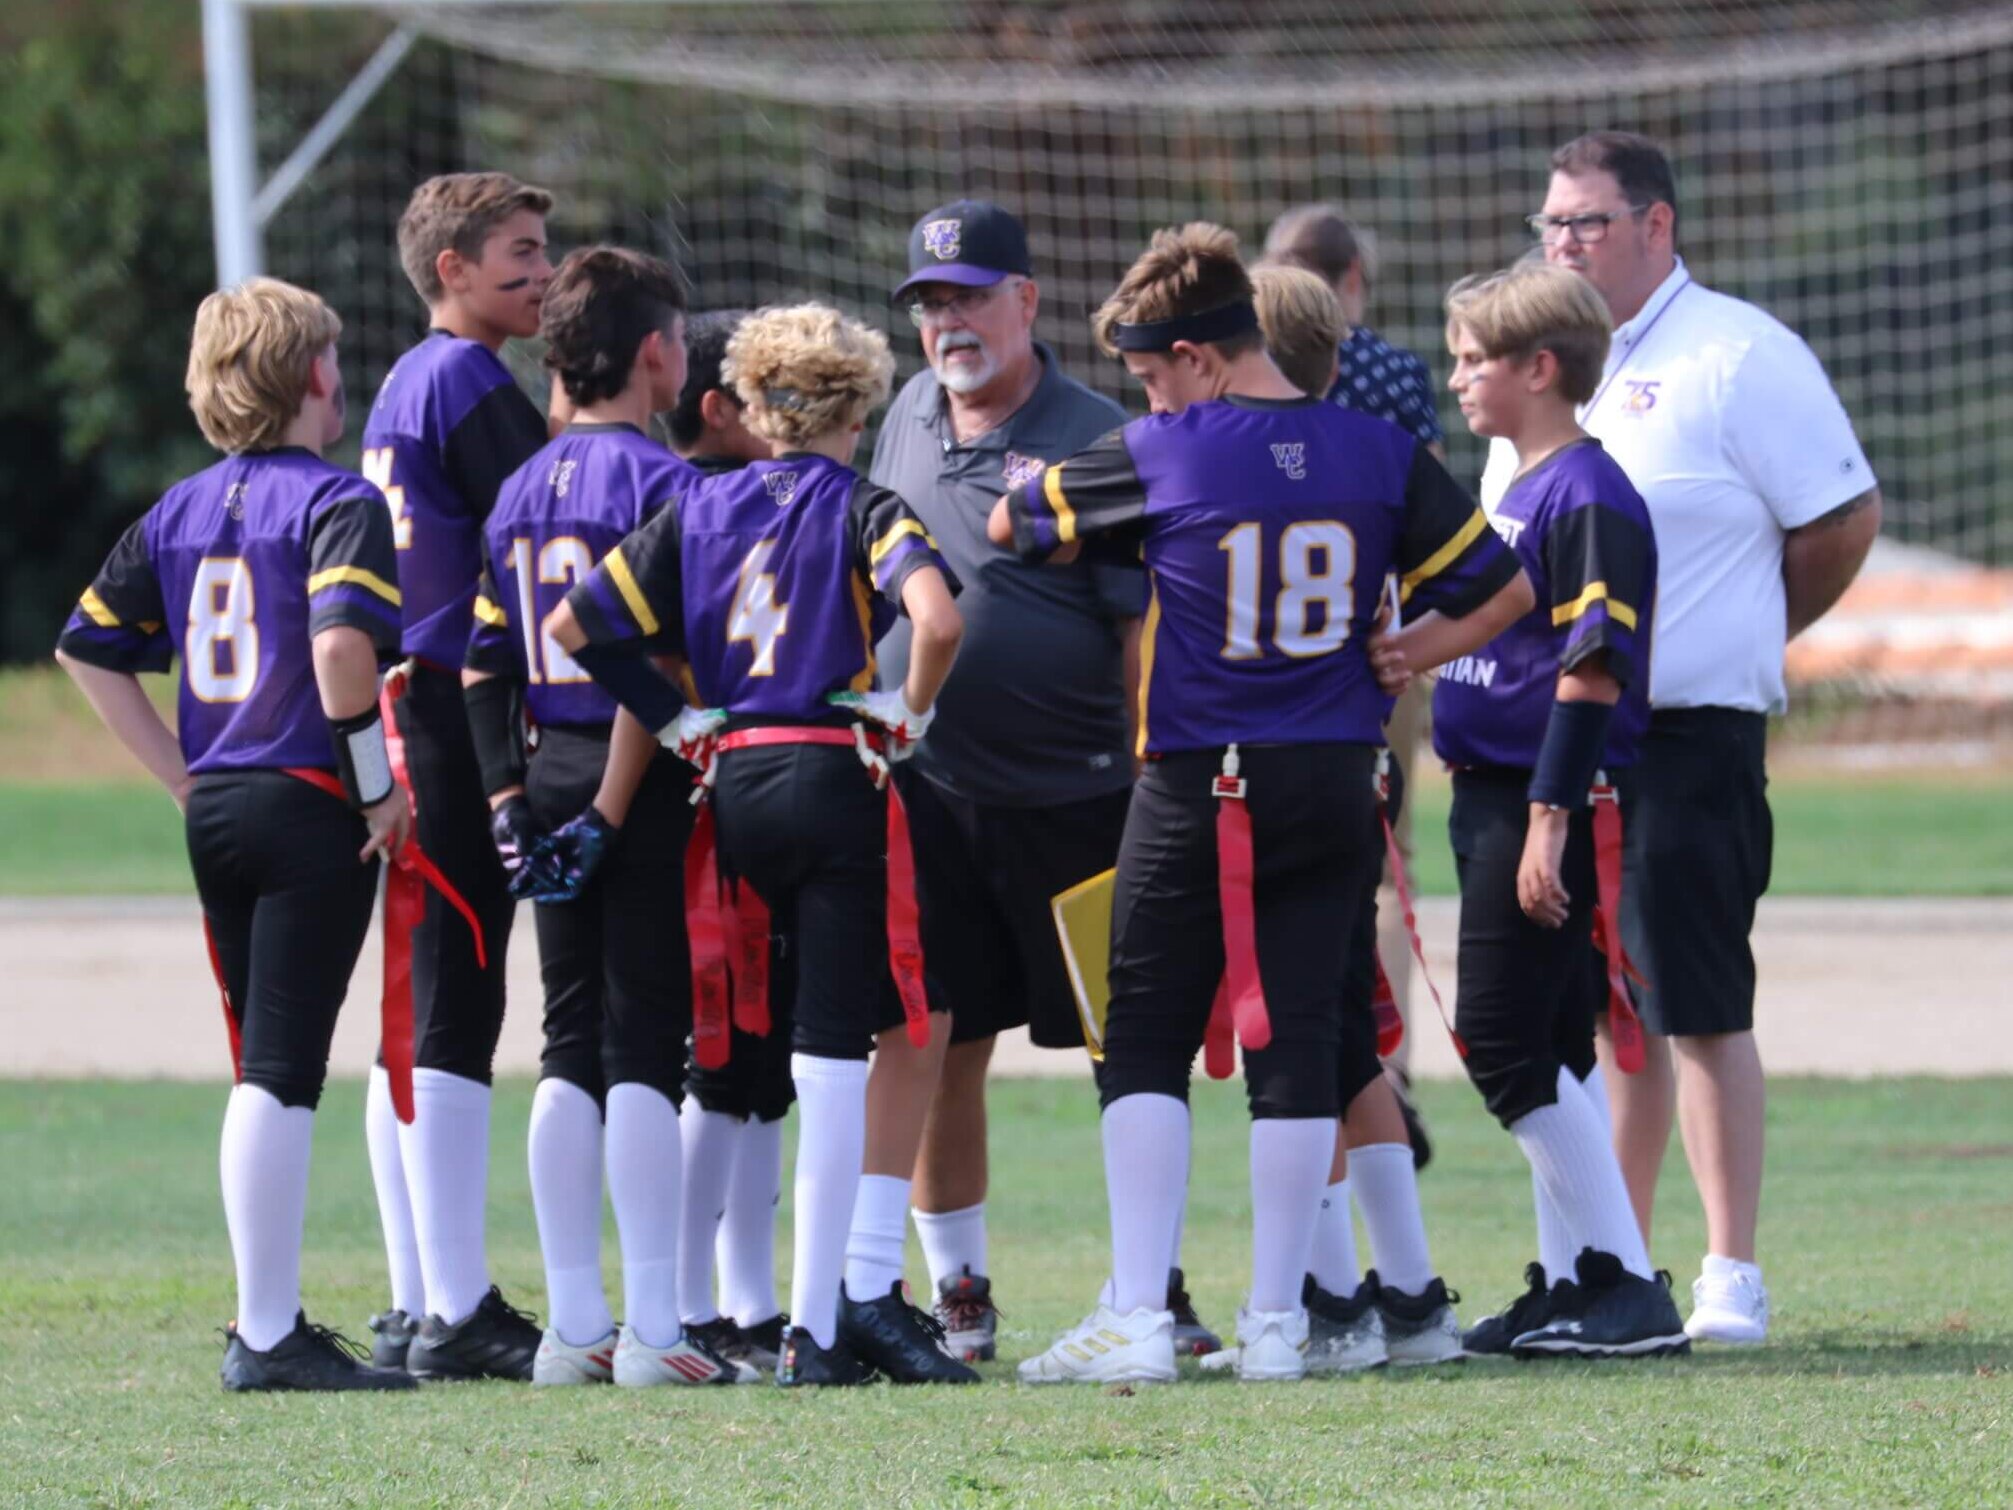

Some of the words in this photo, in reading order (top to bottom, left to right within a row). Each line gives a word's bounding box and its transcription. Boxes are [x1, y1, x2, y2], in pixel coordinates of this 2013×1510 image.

[185, 557, 259, 703] 8
[506, 535, 594, 685] 12
[727, 539, 790, 677] 4
[1217, 519, 1356, 660] 18
